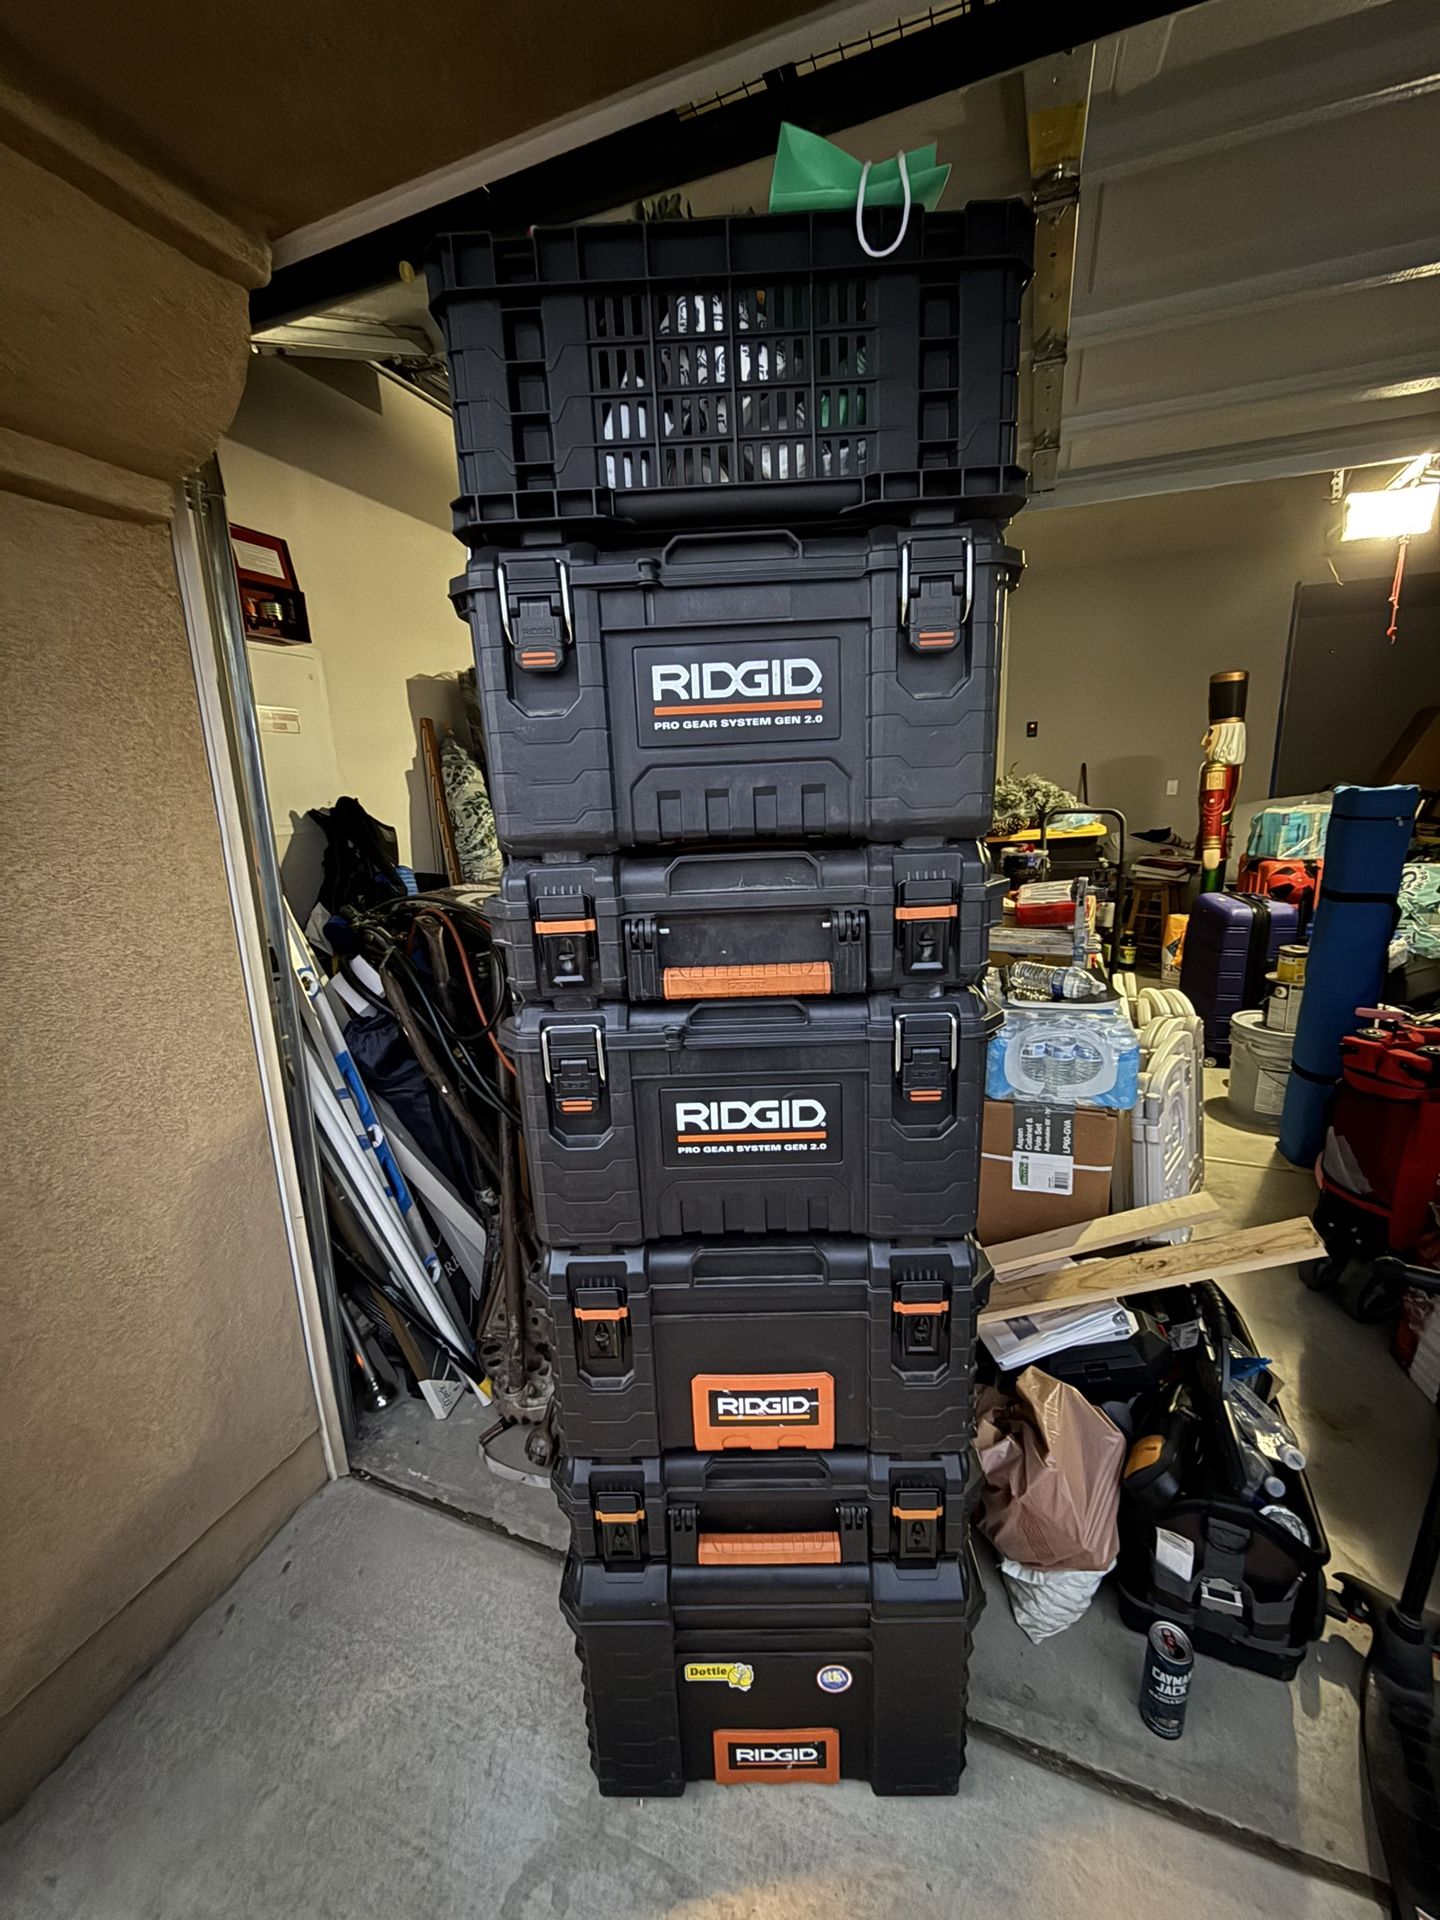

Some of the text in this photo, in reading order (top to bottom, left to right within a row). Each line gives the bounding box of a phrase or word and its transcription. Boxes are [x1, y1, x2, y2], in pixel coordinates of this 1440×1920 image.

[651, 658, 823, 701] RIDGID
[654, 714, 823, 731] PRO GEAR SYSTEM GEN 2.0
[675, 1099, 827, 1131] RIDGID
[677, 1146, 701, 1154] PRO
[703, 1145, 734, 1153] GEAR
[736, 1144, 781, 1153] SYSTEM
[783, 1143, 807, 1151] GEN
[1016, 1127, 1024, 1150] Aspen
[1025, 1124, 1033, 1151] Cabinet
[1034, 1123, 1043, 1151] Pole Set
[717, 1396, 810, 1415] RIDGID
[736, 1747, 818, 1762] RIDGID
